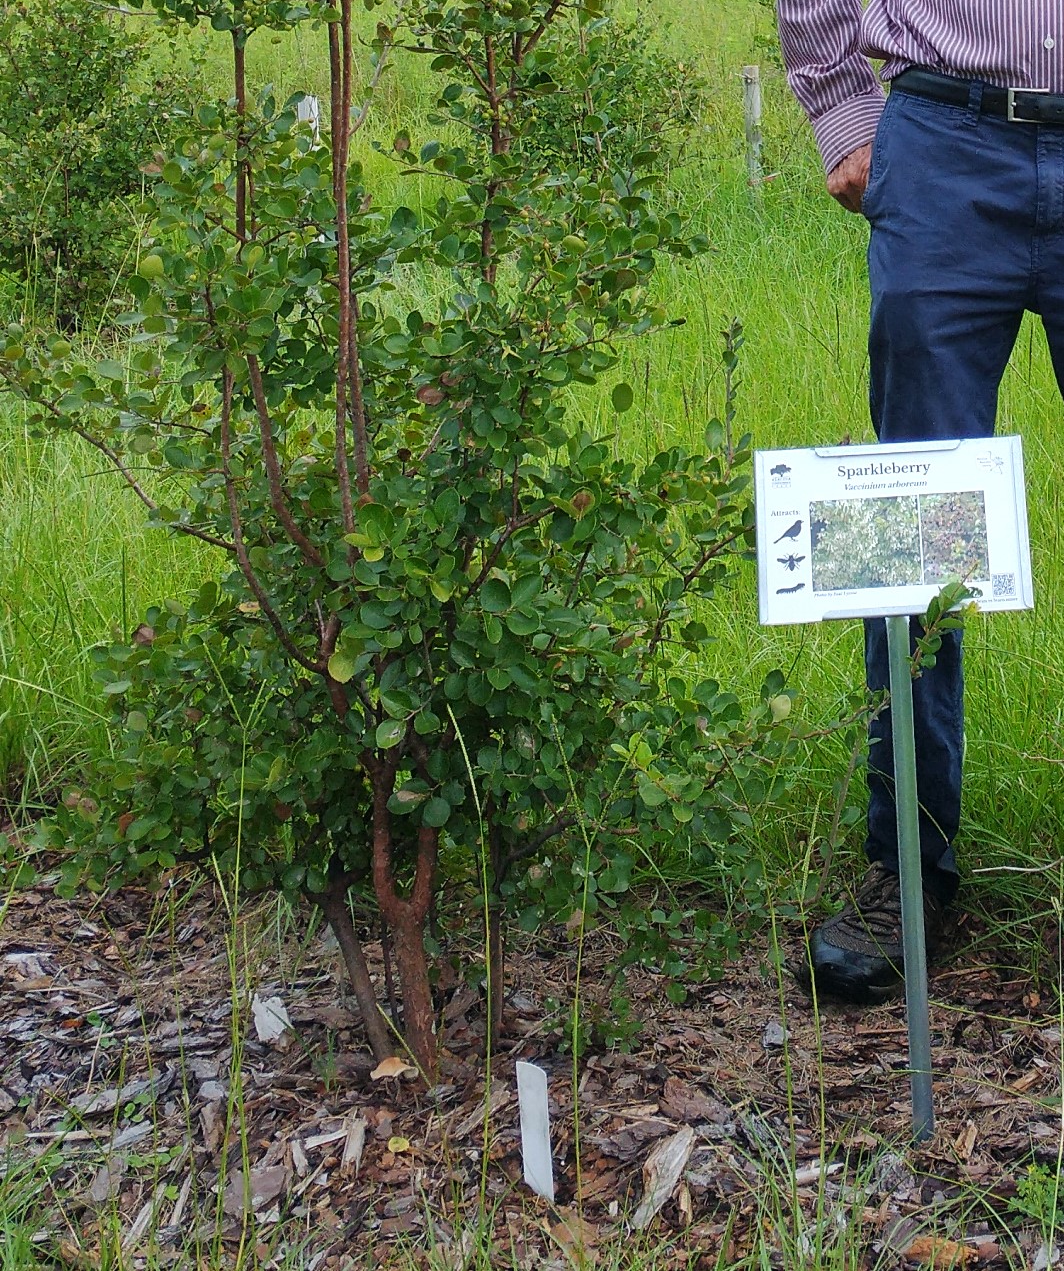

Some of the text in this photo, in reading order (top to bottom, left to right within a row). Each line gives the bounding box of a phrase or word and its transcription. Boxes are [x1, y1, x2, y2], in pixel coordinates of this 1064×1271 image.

[837, 462, 931, 480] Sparkleberry
[844, 480, 928, 491] Vaccinium arboreum
[770, 509, 801, 517] Attracts:
